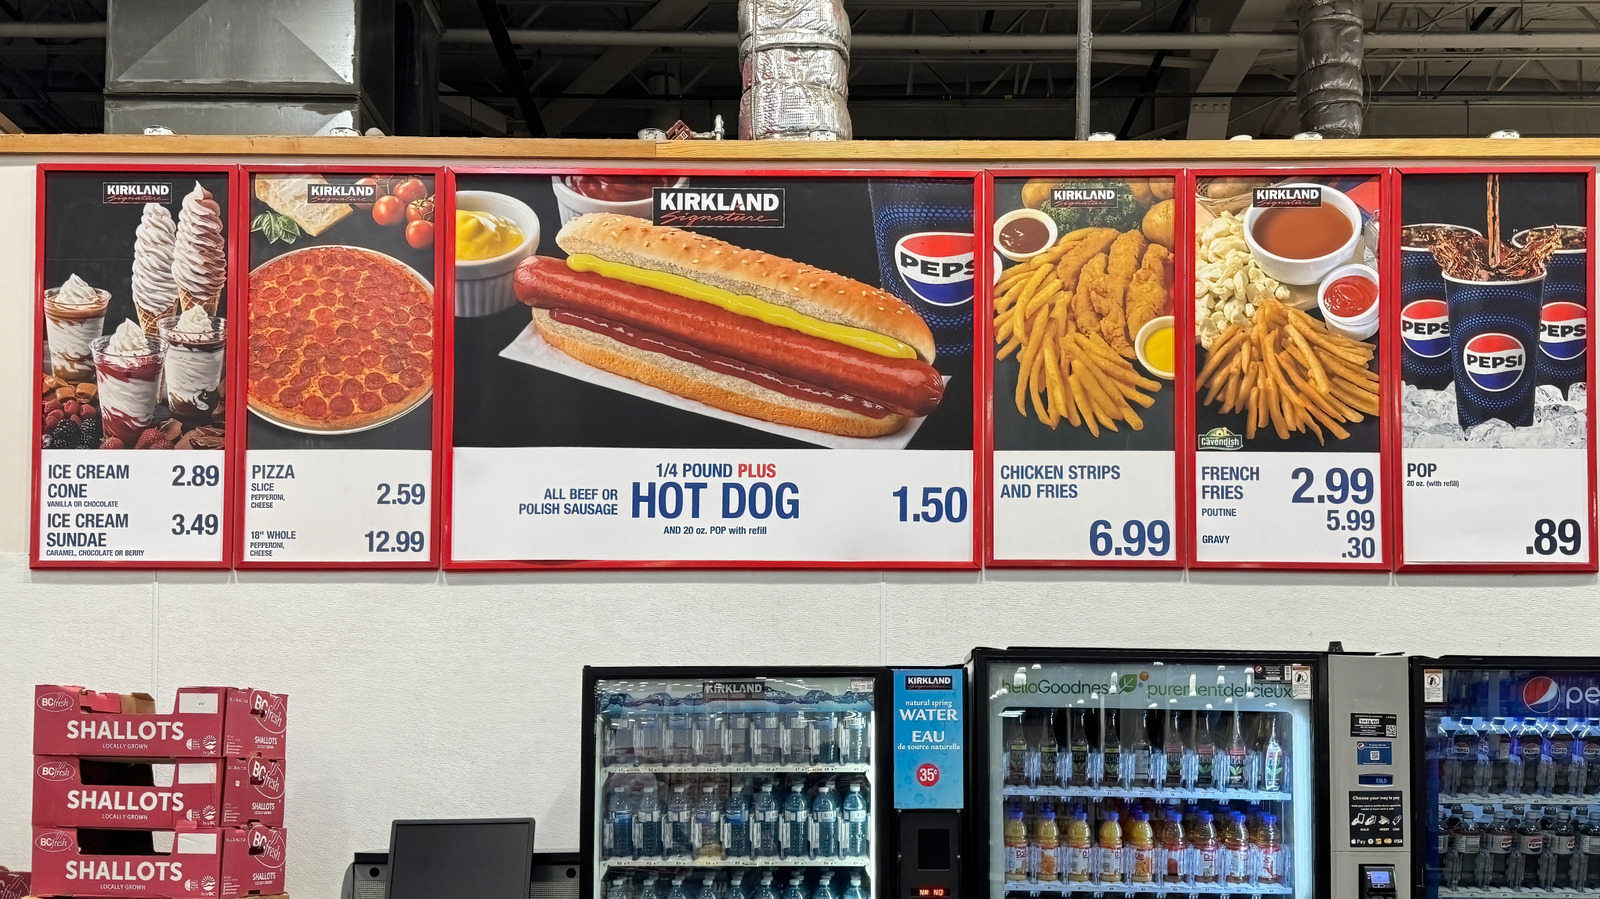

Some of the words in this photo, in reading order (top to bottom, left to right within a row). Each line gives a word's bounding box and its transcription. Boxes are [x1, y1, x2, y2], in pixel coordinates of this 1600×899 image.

[107, 185, 169, 195] KIRKLAND
[311, 186, 374, 196] KIRKLAND
[1054, 190, 1115, 200] KIRKLAND
[1256, 189, 1319, 200] KIRKLAND
[660, 192, 779, 211] KIRKLAND
[660, 210, 779, 227] Signature
[1467, 353, 1523, 369] PEPSI
[1201, 437, 1239, 446] Cavendish
[48, 464, 71, 479] ICE
[76, 464, 129, 479] CREAM
[172, 465, 219, 486] 2.89
[252, 464, 295, 479] PIZZA
[656, 463, 678, 478] 1/4
[683, 463, 732, 478] POUND
[738, 463, 776, 478] PLUS
[1000, 465, 1063, 480] CHICKEN
[1068, 465, 1121, 480] STRIPS
[1201, 466, 1260, 481] FRENCH
[1407, 463, 1437, 477] POP
[47, 483, 88, 498] CONE
[251, 482, 275, 492] SLICE
[1000, 484, 1031, 499] AND
[1036, 484, 1078, 499] FRIES
[1291, 467, 1374, 504] 2.99
[1426, 480, 1442, 488] (with
[1443, 480, 1460, 488] refill)
[376, 483, 426, 505] 2.59
[544, 488, 566, 500] ALL
[570, 488, 599, 500] BEEF
[602, 488, 618, 500] OR
[631, 481, 708, 519] HOT
[722, 482, 799, 519] DOG
[1201, 485, 1244, 500] FRIES
[518, 503, 560, 515] POLISH
[563, 503, 618, 515] SAUSAGE
[892, 486, 968, 523] 1.50
[1201, 508, 1237, 517] POUTINE
[1326, 509, 1375, 531] 5.99
[47, 513, 70, 528] ICE
[75, 513, 129, 528] CREAM
[171, 514, 219, 535] 3.49
[250, 531, 264, 539] 18"
[266, 530, 296, 539] WHOLE
[663, 526, 681, 535] AND
[683, 526, 694, 535] 20
[709, 526, 726, 535] POP
[728, 526, 746, 535] with
[748, 526, 767, 535] refill
[1089, 519, 1171, 557] 6.99
[1526, 518, 1582, 556] .89
[46, 532, 107, 547] SUNDAE
[250, 542, 285, 550] PEPPERONI,
[364, 530, 425, 552] 12.99
[1202, 535, 1230, 544] GRAVY
[1342, 537, 1376, 559] .30
[706, 683, 763, 694] KIRKLAND
[1147, 683, 1292, 699] pureentdelicieux
[931, 700, 953, 708] spring
[1566, 687, 1600, 710] pe
[899, 708, 958, 721] WATER
[66, 720, 184, 740] SHALLOTS
[912, 730, 945, 743] EAU
[254, 736, 277, 745] SHALLOTS
[919, 768, 938, 781] 35¢
[67, 790, 184, 811] SHALLOTS
[252, 802, 275, 811] SHALLOTS
[65, 860, 183, 881] SHALLOTS
[252, 872, 276, 881] SHALLOTS
